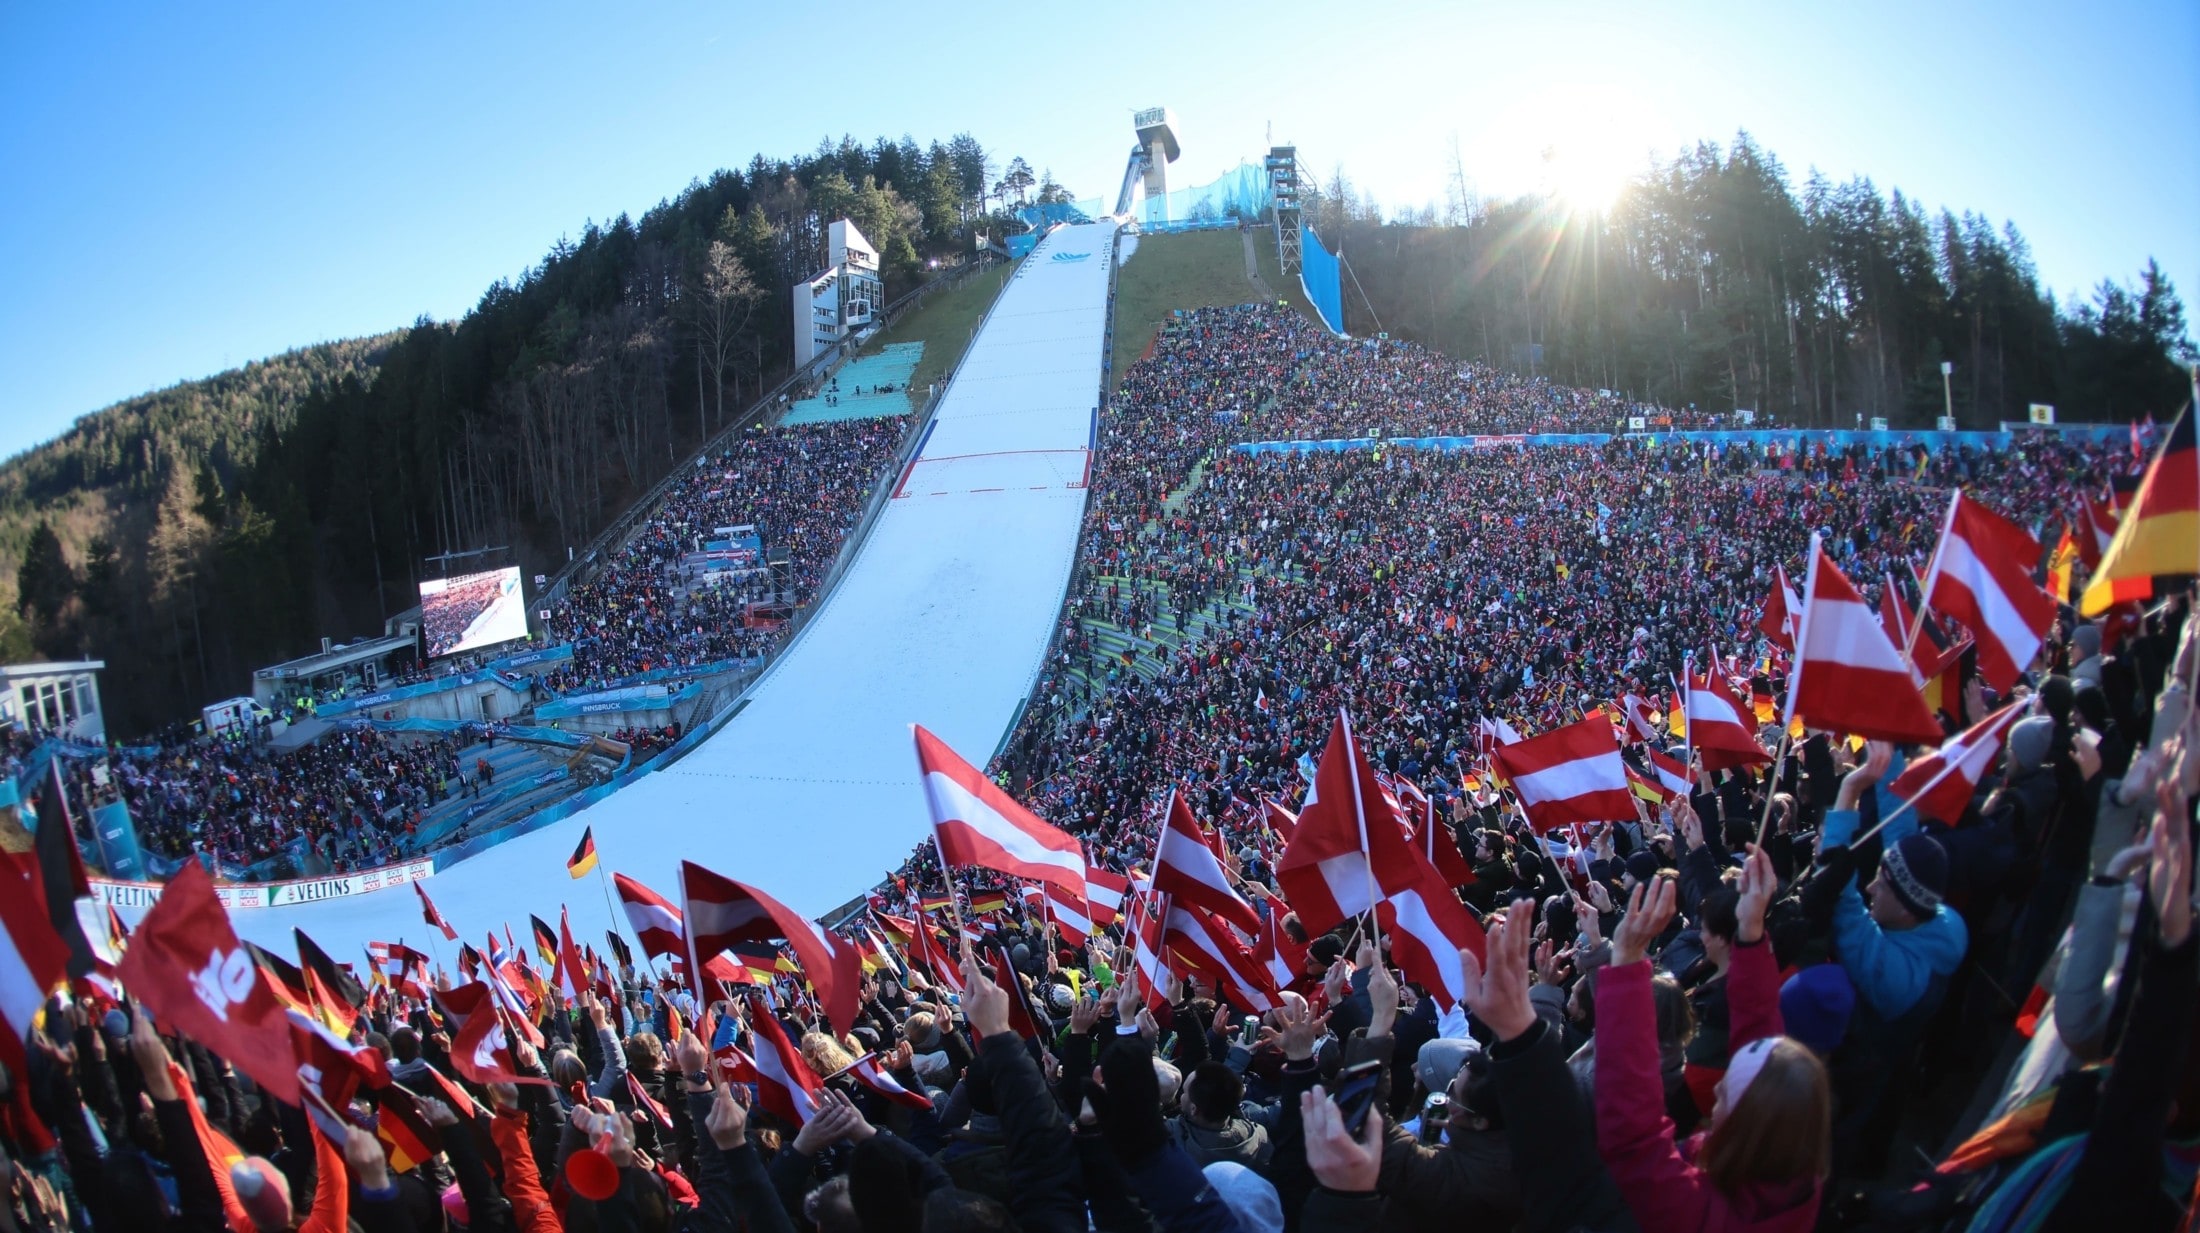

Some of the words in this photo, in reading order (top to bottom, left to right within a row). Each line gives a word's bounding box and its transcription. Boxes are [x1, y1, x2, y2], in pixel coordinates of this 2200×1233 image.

[510, 653, 541, 666] INNSBRUCK
[355, 693, 392, 708] INNSBRUCK
[582, 702, 621, 712] INNSBRUCK
[364, 880, 380, 890] MOLY
[387, 876, 404, 886] MOLY
[105, 885, 163, 907] VELTIN
[297, 879, 350, 901] VELTINS
